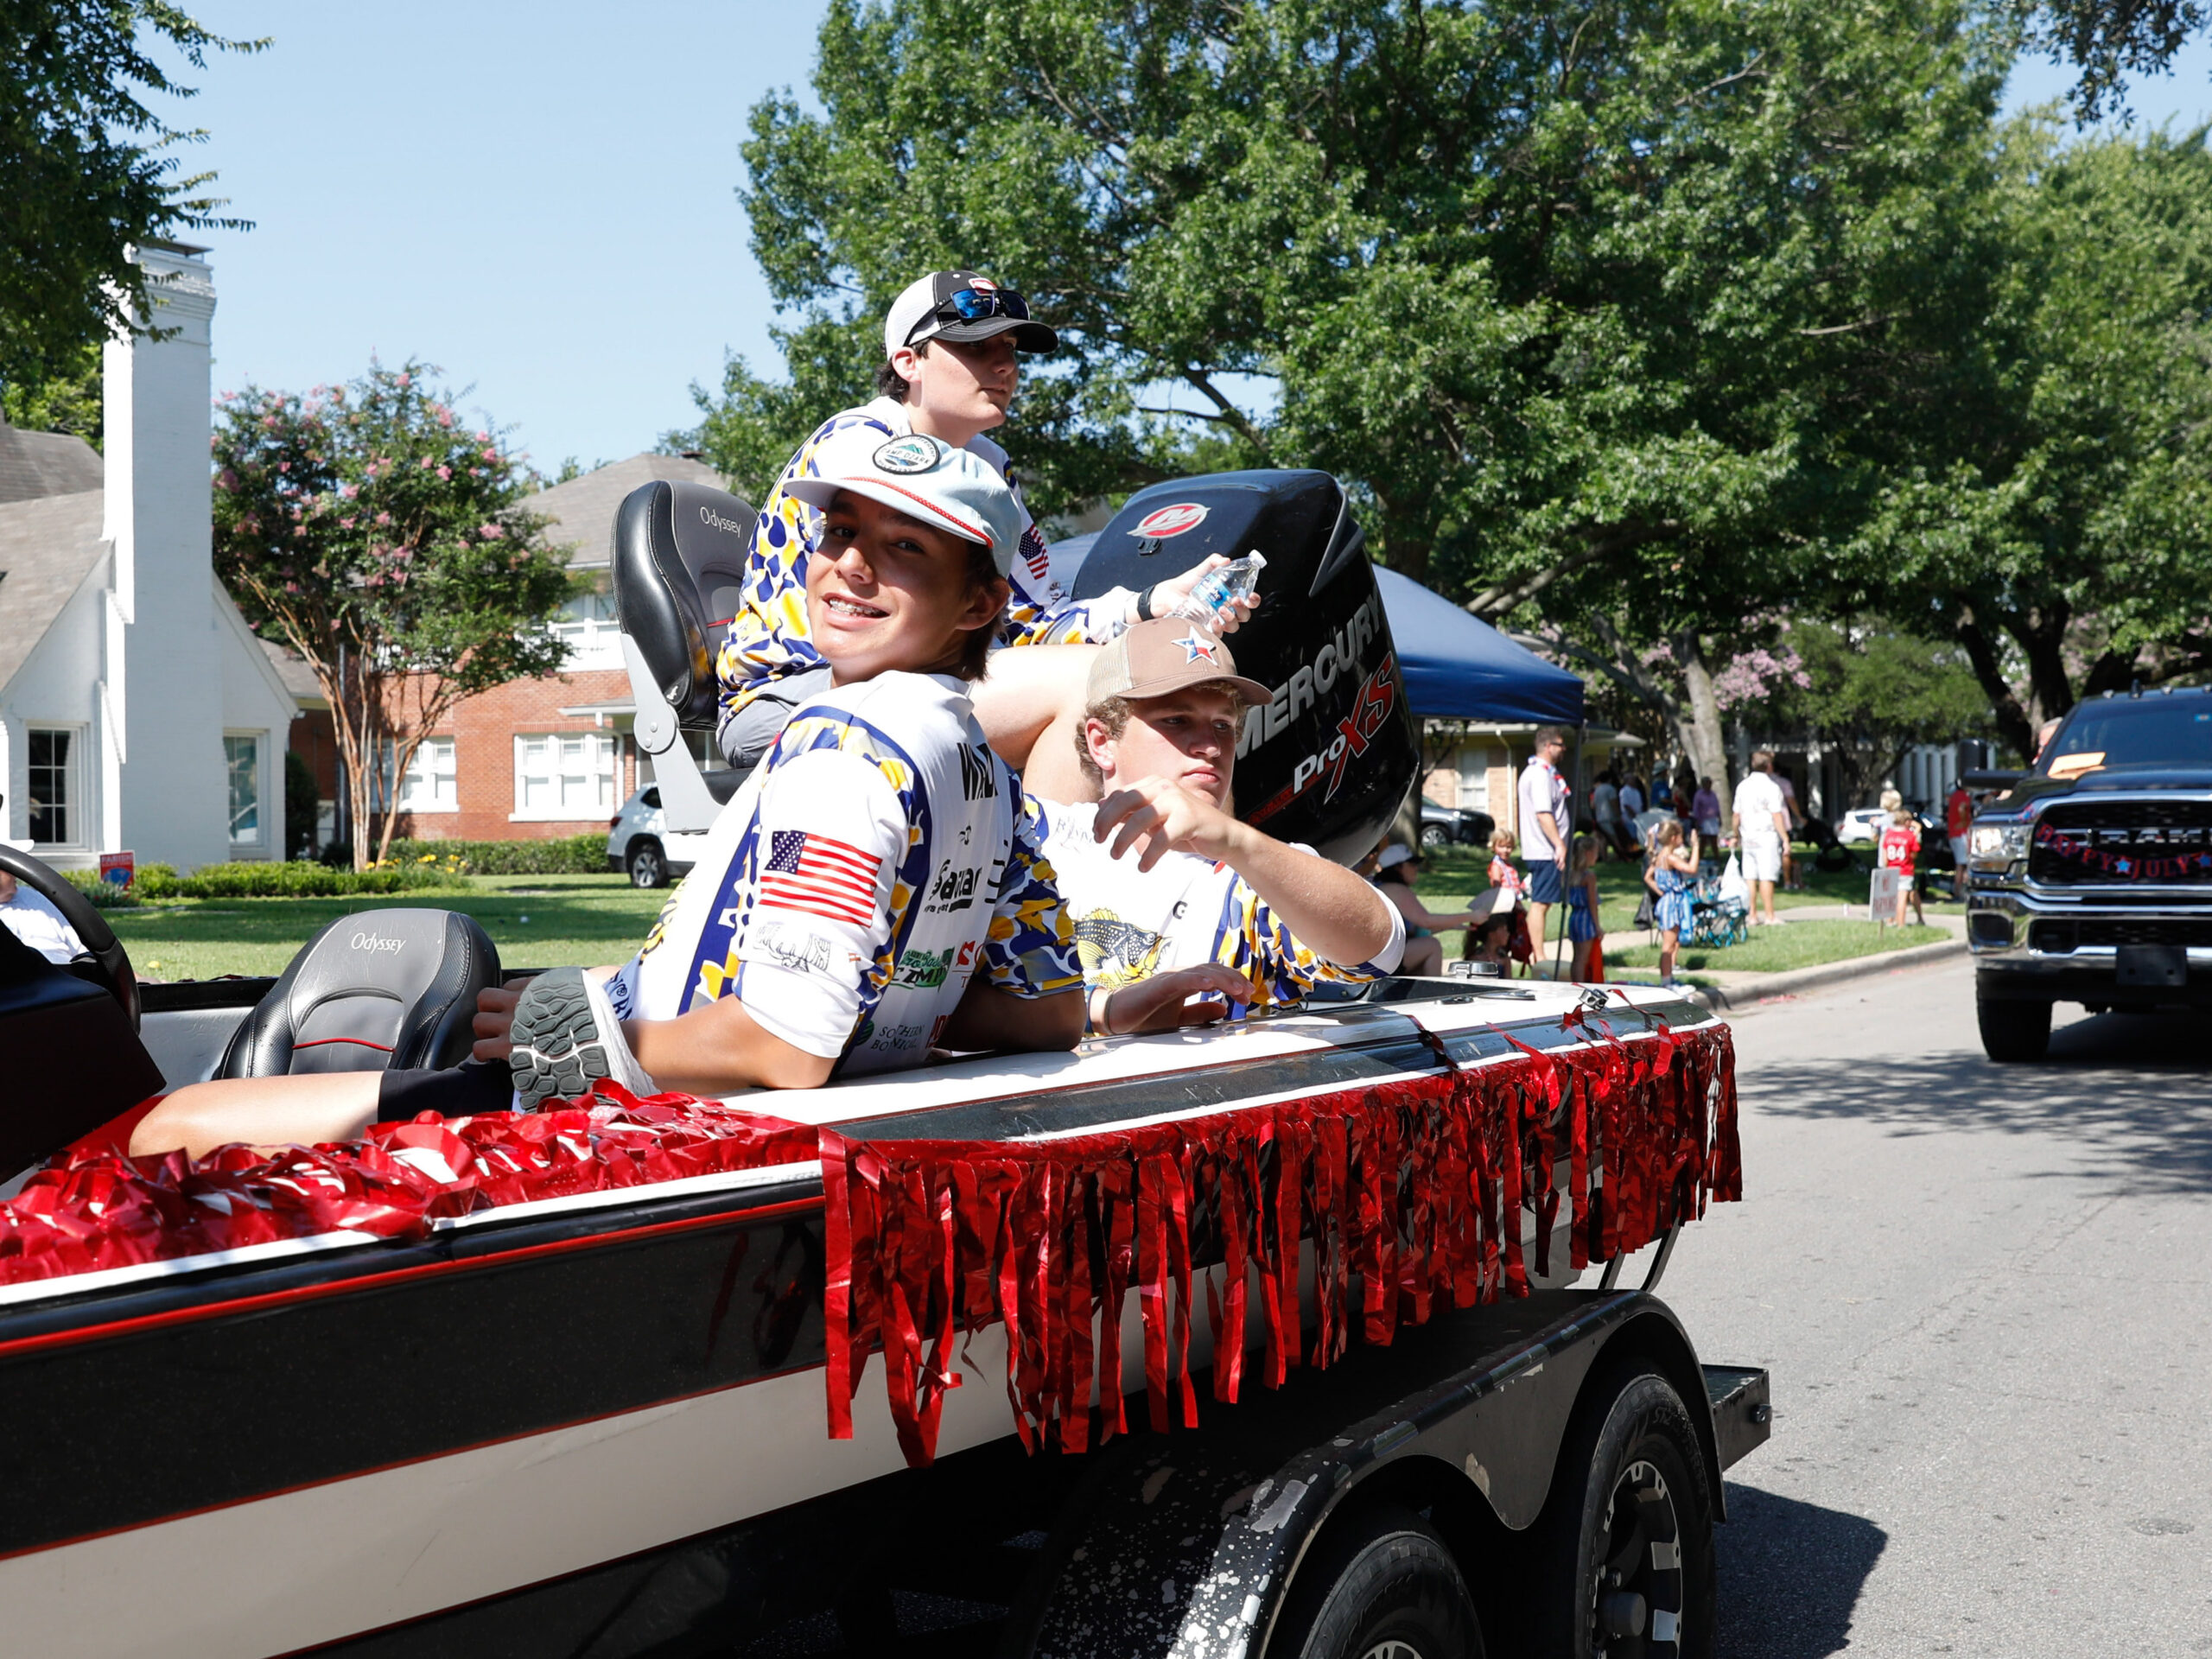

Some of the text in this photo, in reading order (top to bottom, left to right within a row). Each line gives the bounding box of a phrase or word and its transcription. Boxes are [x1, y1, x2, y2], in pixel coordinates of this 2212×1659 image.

[1236, 589, 1381, 761] MERCURY
[2098, 828, 2202, 844] RAM
[1886, 843, 1906, 861] 84
[2035, 823, 2191, 880] HAPPY JULY
[351, 931, 407, 956] Odyssey
